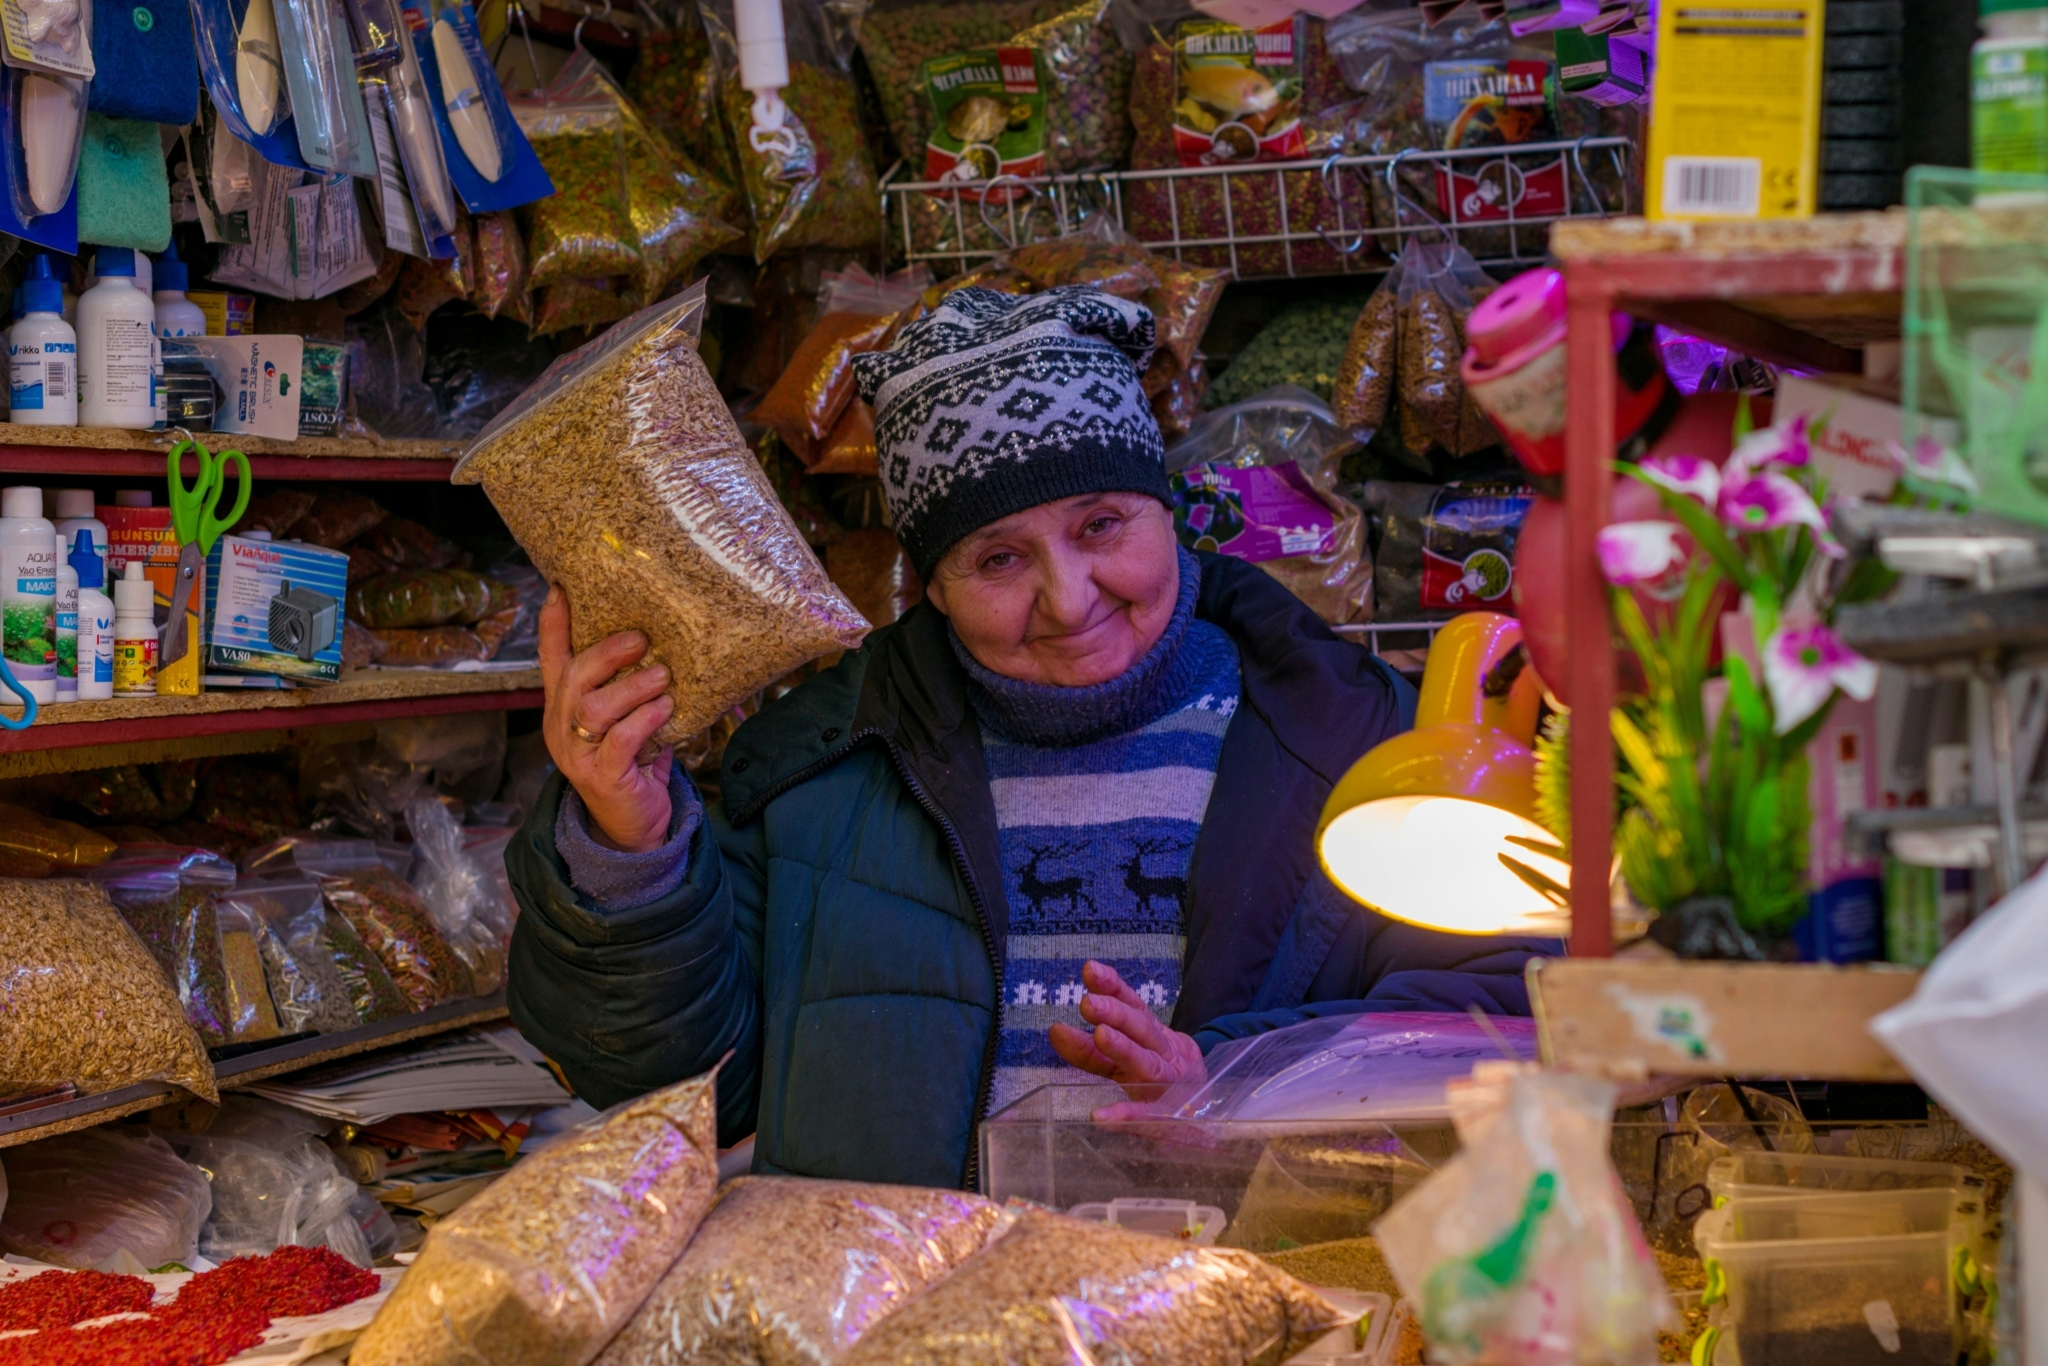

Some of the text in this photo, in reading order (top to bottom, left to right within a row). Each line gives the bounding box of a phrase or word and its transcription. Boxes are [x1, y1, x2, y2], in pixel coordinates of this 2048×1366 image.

[18, 345, 40, 355] rikka
[248, 342, 259, 425] MAGNETIC BRUSH
[239, 392, 247, 420] SMALL
[110, 530, 176, 542] SUNSUN
[231, 544, 282, 565] ViaAqua
[221, 647, 251, 662] VA80
